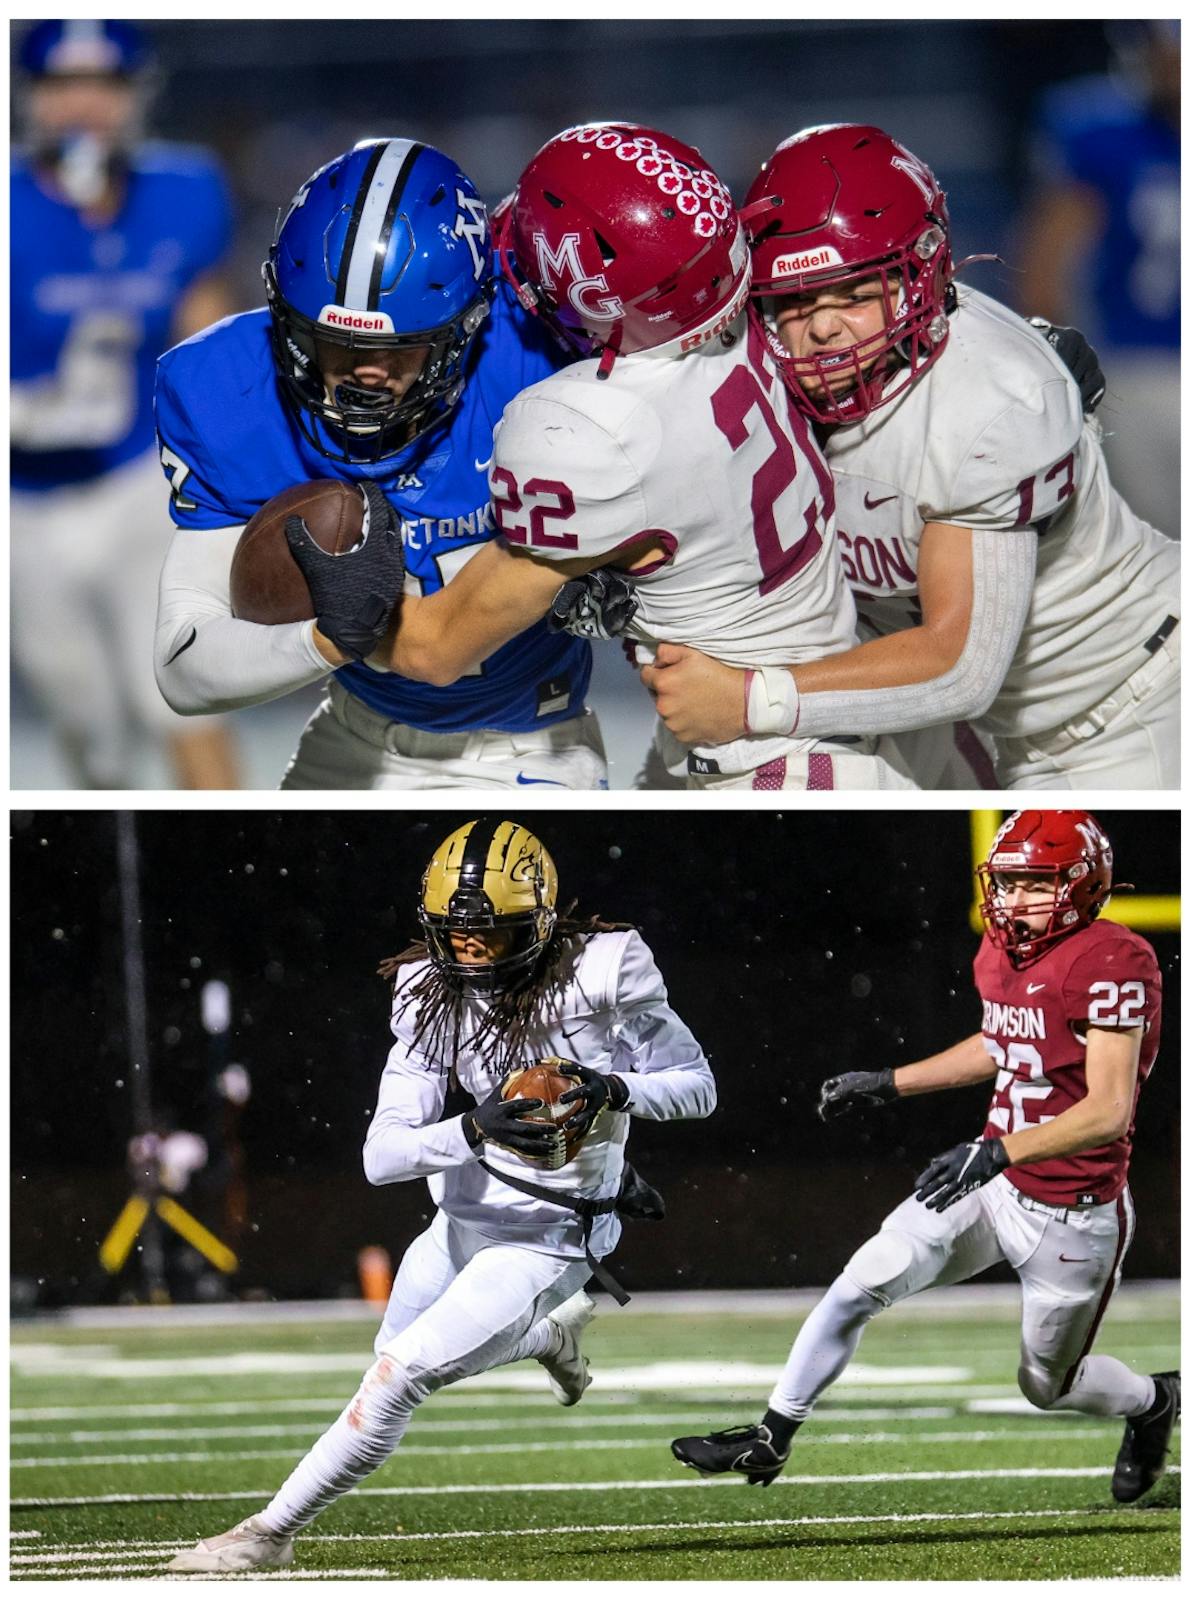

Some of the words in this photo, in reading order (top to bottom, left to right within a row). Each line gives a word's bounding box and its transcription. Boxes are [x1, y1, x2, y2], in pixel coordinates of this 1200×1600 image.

[776, 251, 831, 273] Riddell
[326, 312, 384, 331] Riddell
[1014, 452, 1076, 527] 13
[490, 465, 579, 551] 22
[696, 758, 709, 774] M
[1088, 981, 1146, 1027] 22
